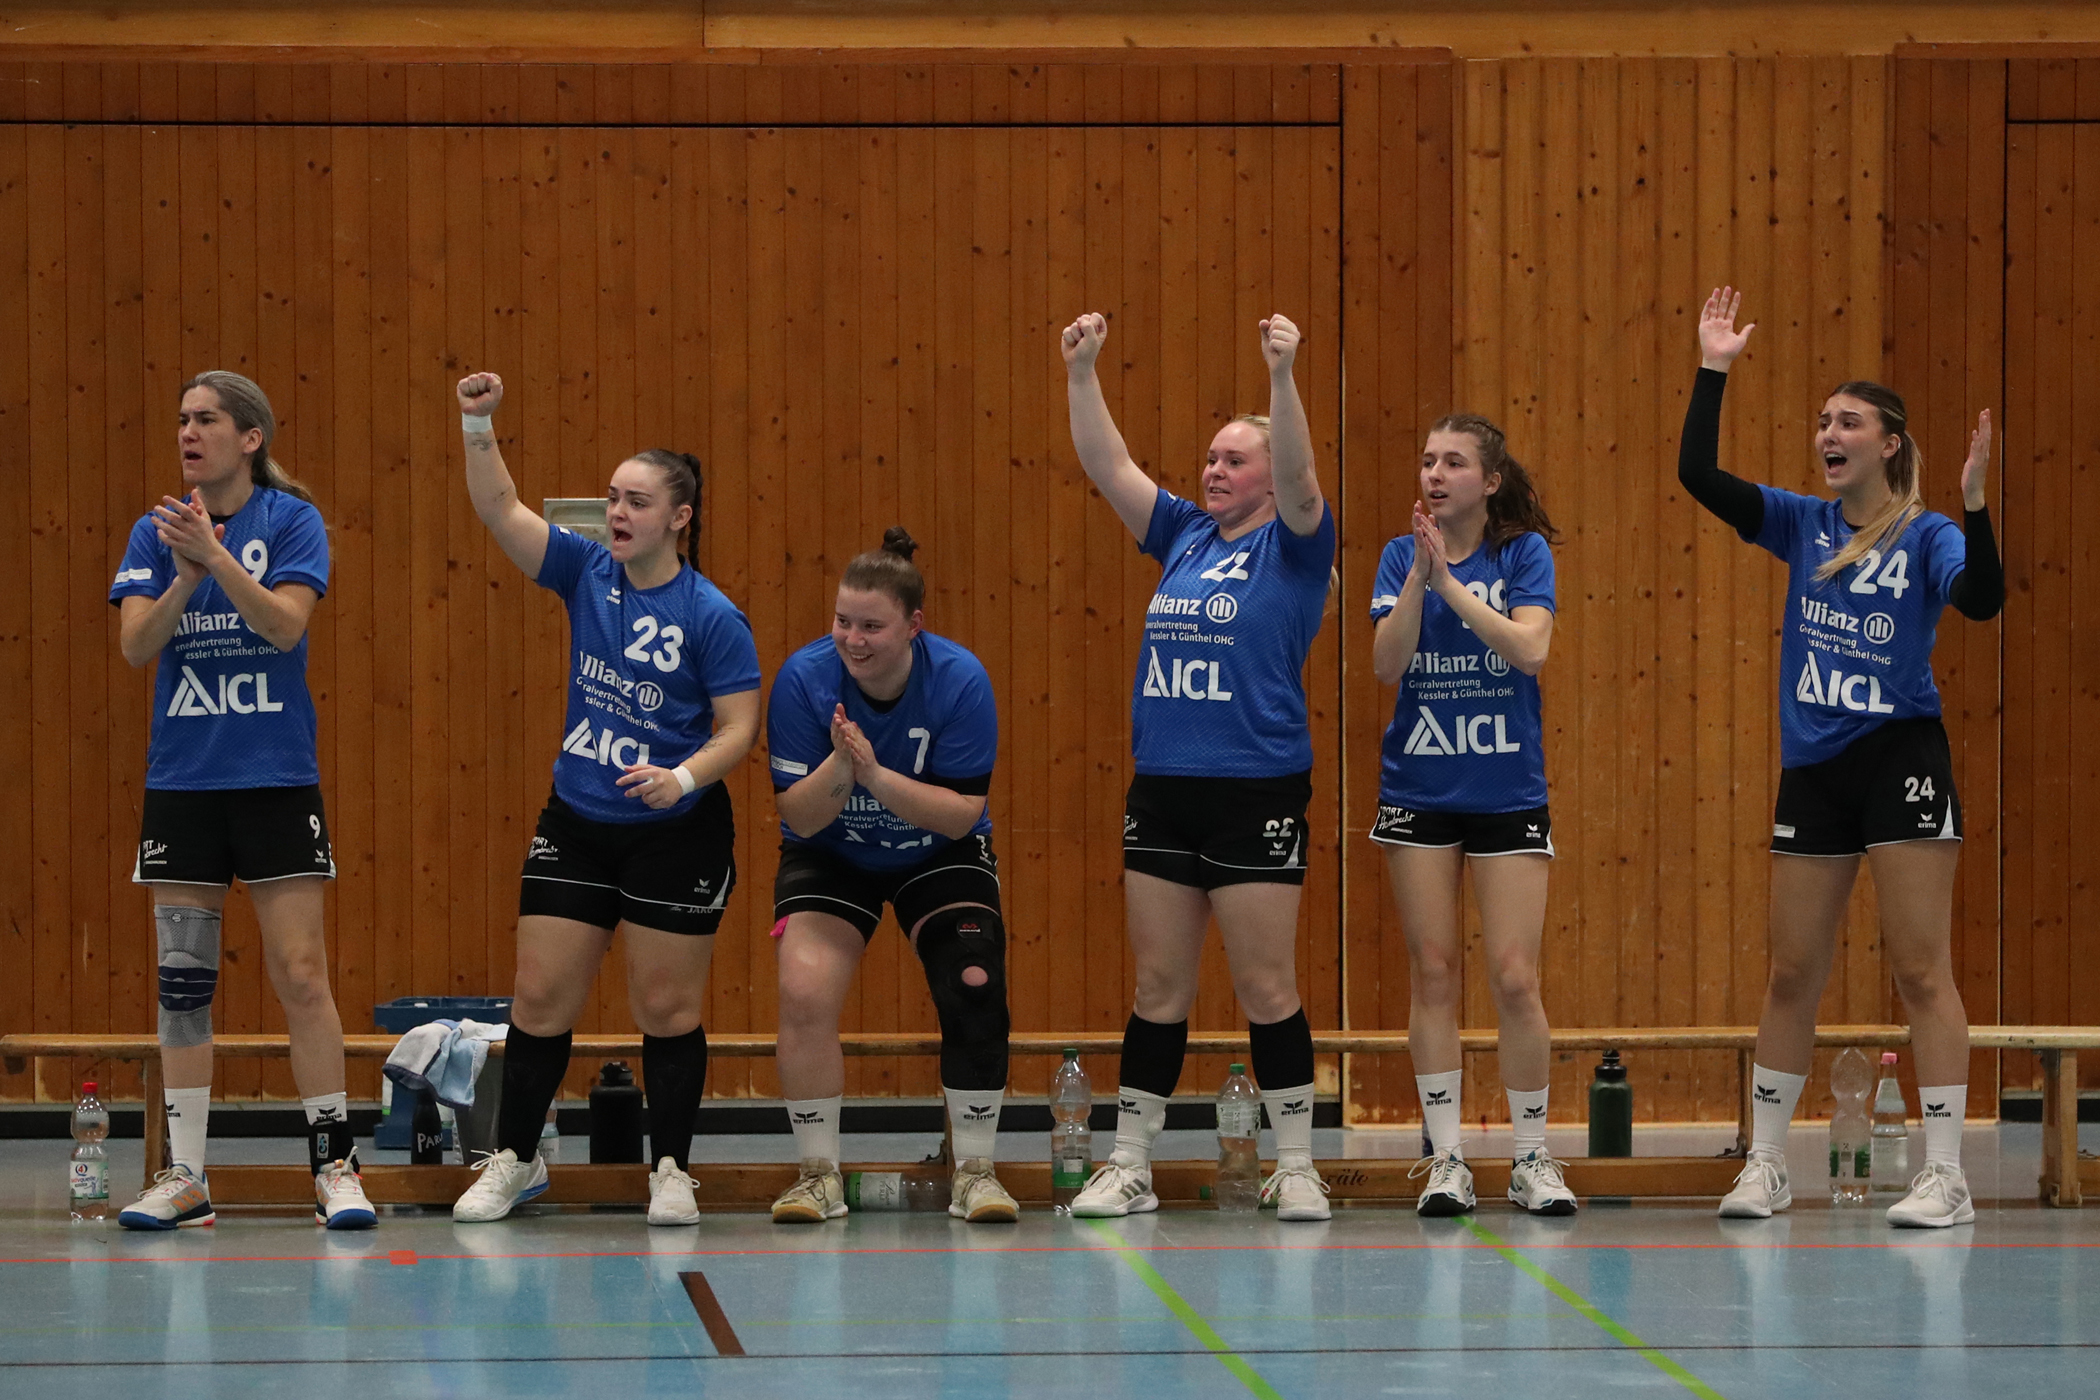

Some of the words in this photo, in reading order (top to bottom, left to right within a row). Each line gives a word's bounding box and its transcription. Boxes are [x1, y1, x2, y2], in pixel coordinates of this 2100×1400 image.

[242, 539, 268, 582] 9
[1850, 550, 1909, 600] 24
[624, 615, 684, 673] 23
[1171, 632, 1176, 640] &
[1178, 632, 1212, 642] Günthel
[1214, 635, 1234, 646] OHG
[214, 649, 220, 657] &
[1872, 654, 1892, 665] OHG
[1418, 691, 1450, 700] Kessler
[1460, 689, 1494, 698] Günthel
[908, 727, 930, 774] 7
[1904, 776, 1936, 802] 24
[309, 814, 321, 840] 9
[1262, 816, 1295, 838] 22
[1426, 1097, 1452, 1106] erima
[1754, 1093, 1781, 1105] erima
[963, 1112, 996, 1121] erima
[1281, 1106, 1309, 1116] erima
[1523, 1111, 1546, 1120] erima
[792, 1116, 824, 1124] erima
